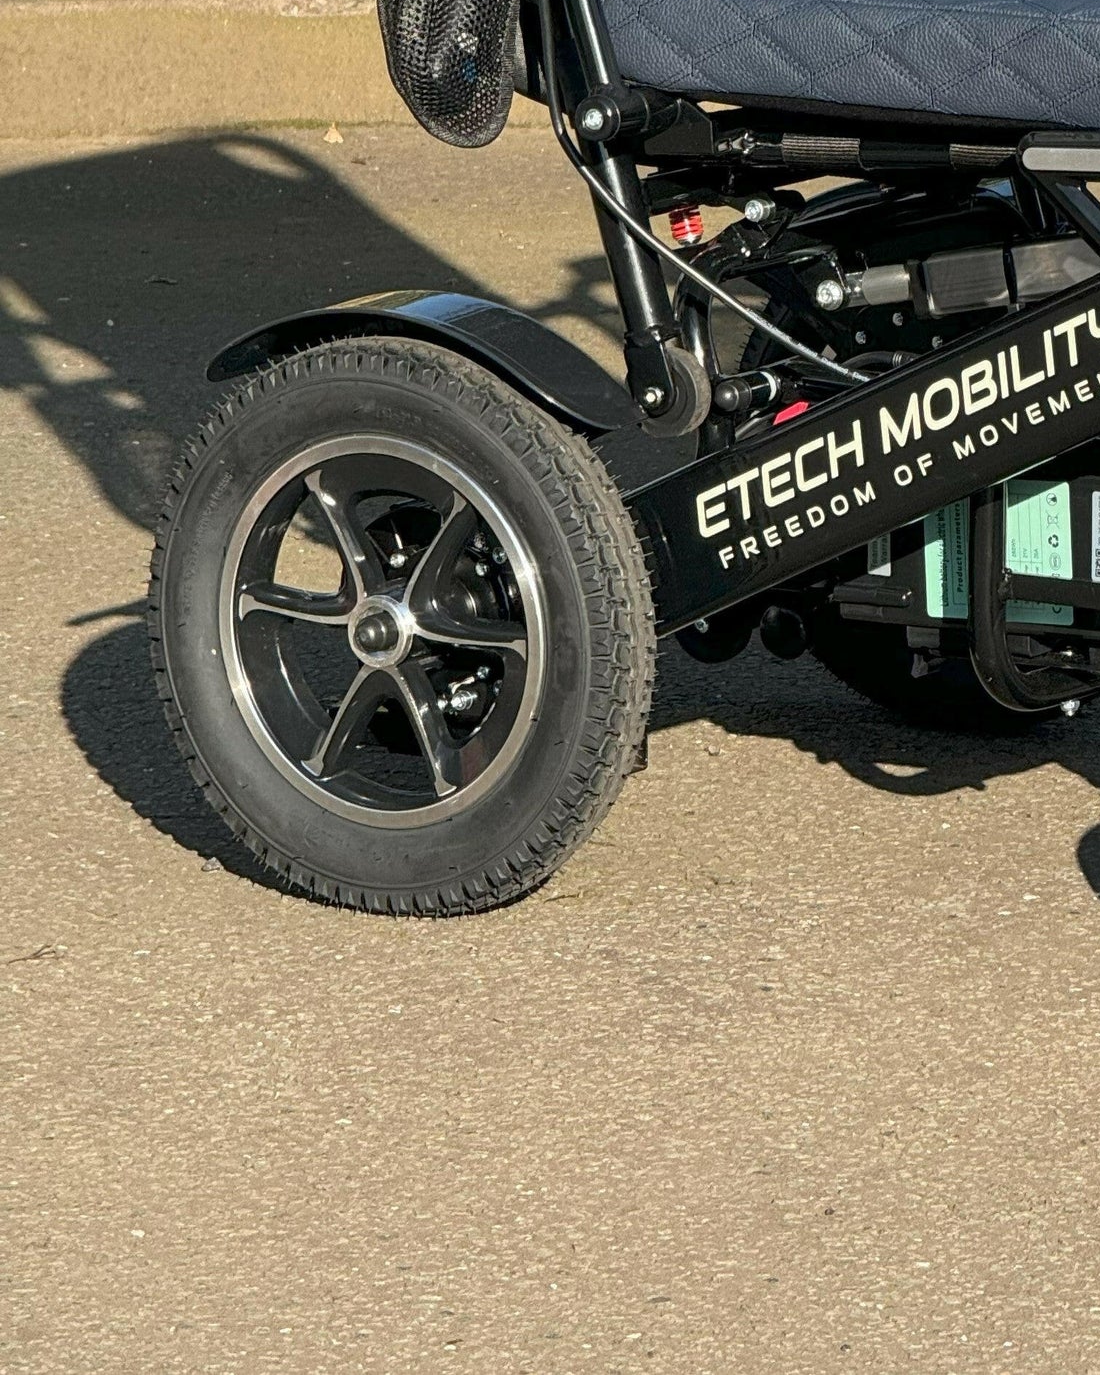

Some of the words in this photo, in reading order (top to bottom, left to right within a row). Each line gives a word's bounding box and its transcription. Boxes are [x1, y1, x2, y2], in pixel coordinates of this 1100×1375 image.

[696, 419, 865, 539] ETECH
[718, 481, 877, 570] FREEDOM
[894, 453, 934, 487] OF
[954, 503, 964, 555] parameters
[956, 557, 964, 593] Product
